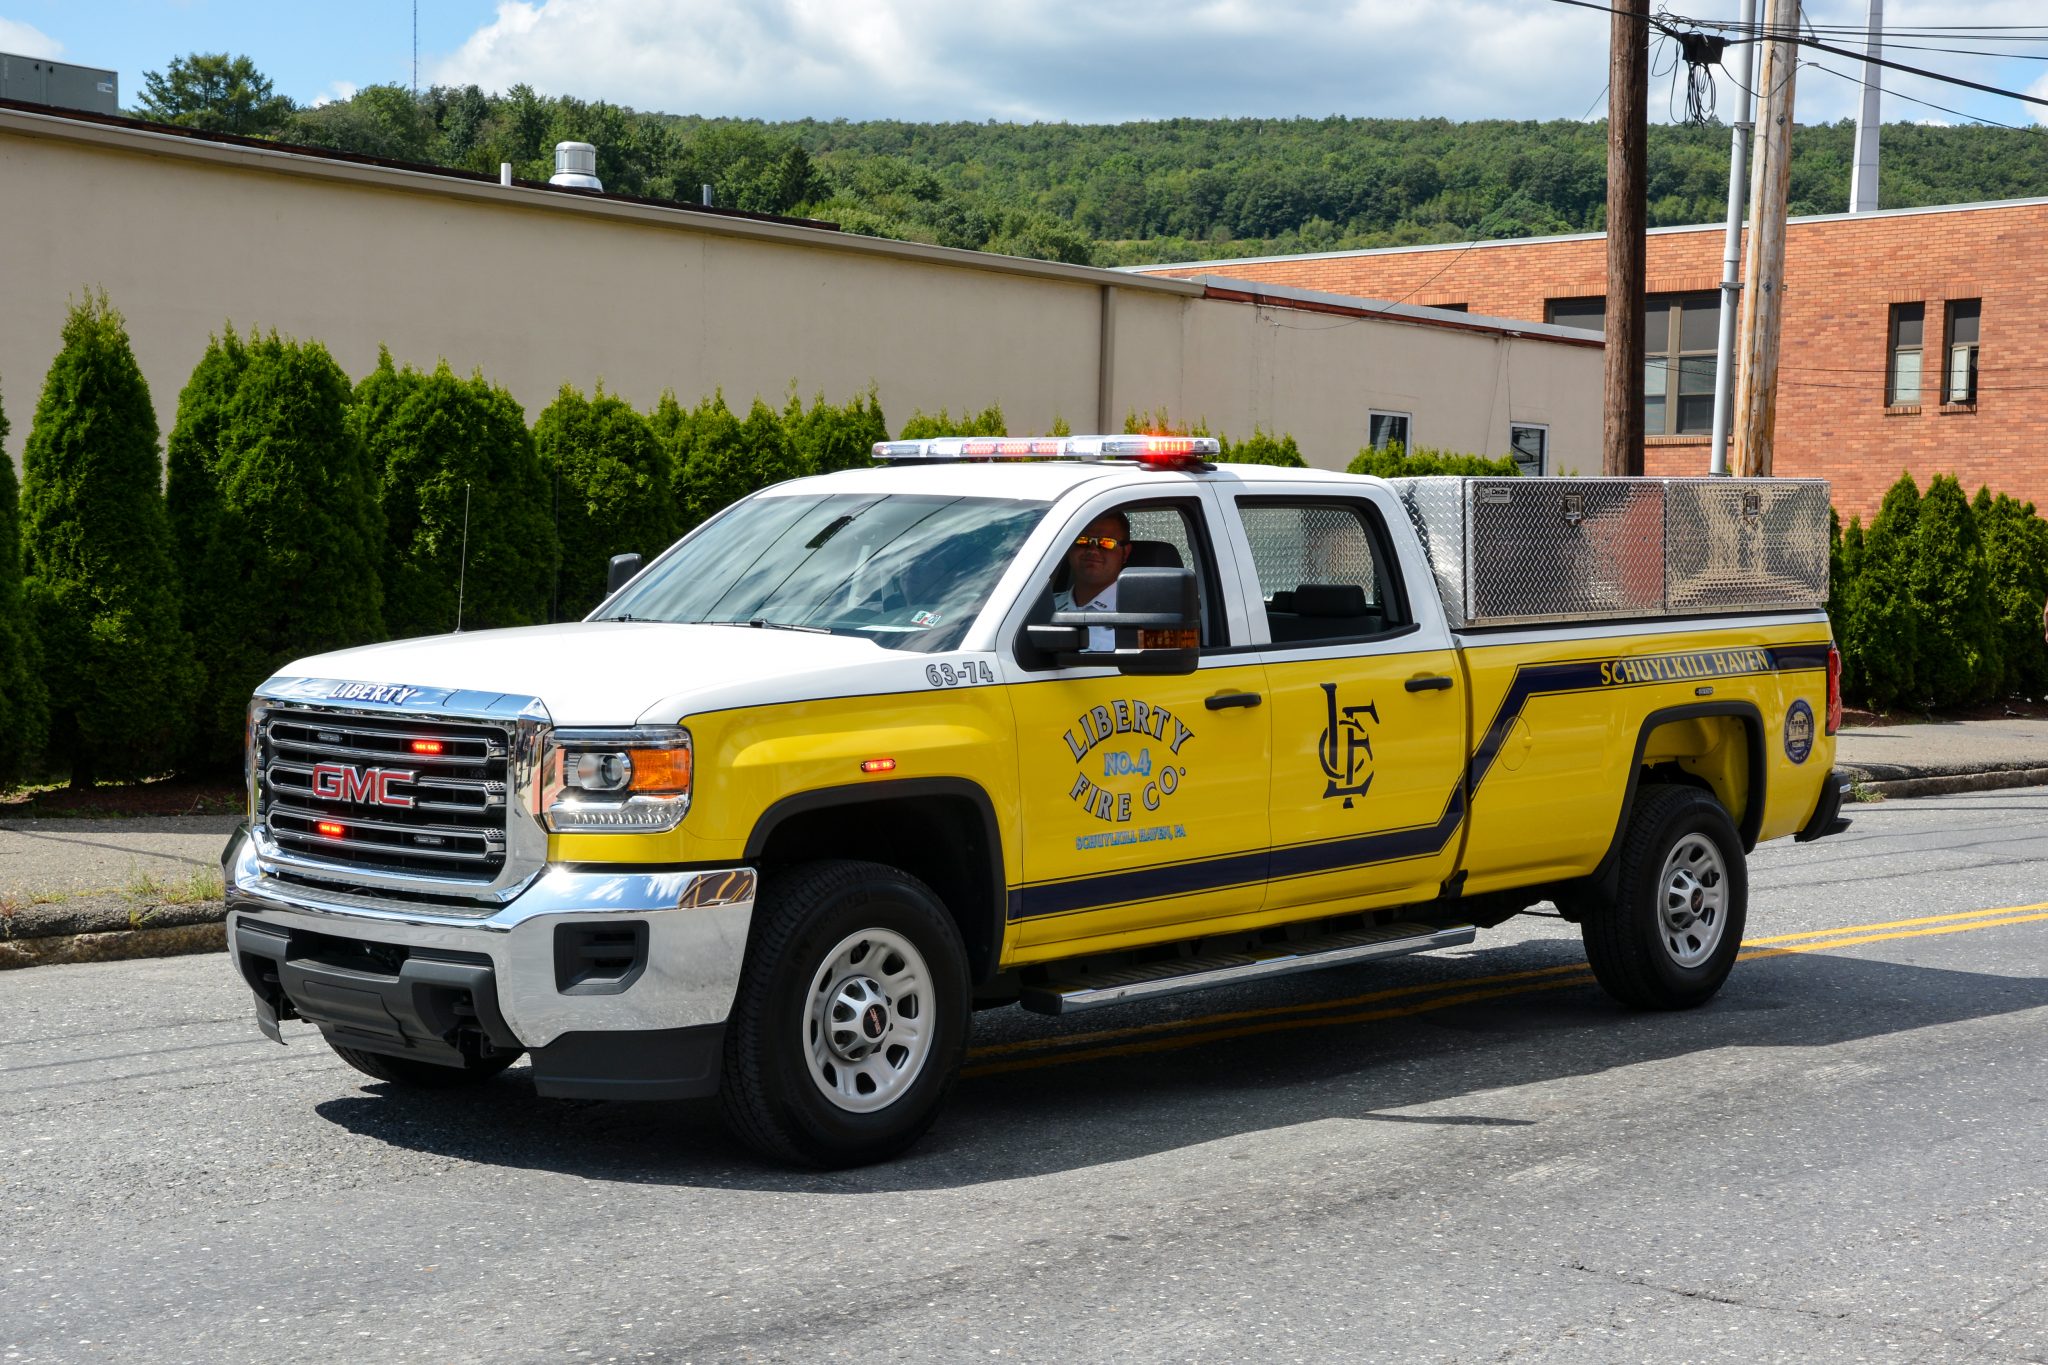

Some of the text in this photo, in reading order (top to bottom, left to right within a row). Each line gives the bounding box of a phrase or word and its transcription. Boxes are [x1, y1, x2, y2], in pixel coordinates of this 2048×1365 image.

[925, 660, 994, 687] 63-74
[1600, 650, 1769, 685] SCHUYLKILL HAVEN
[327, 682, 417, 706] LIBERTY
[1063, 699, 1194, 764] LIBERTY
[312, 762, 416, 808] GMC
[1069, 771, 1132, 823] FIRE
[1076, 830, 1137, 850] SCHUYLKILL
[1174, 824, 1187, 838] PA
